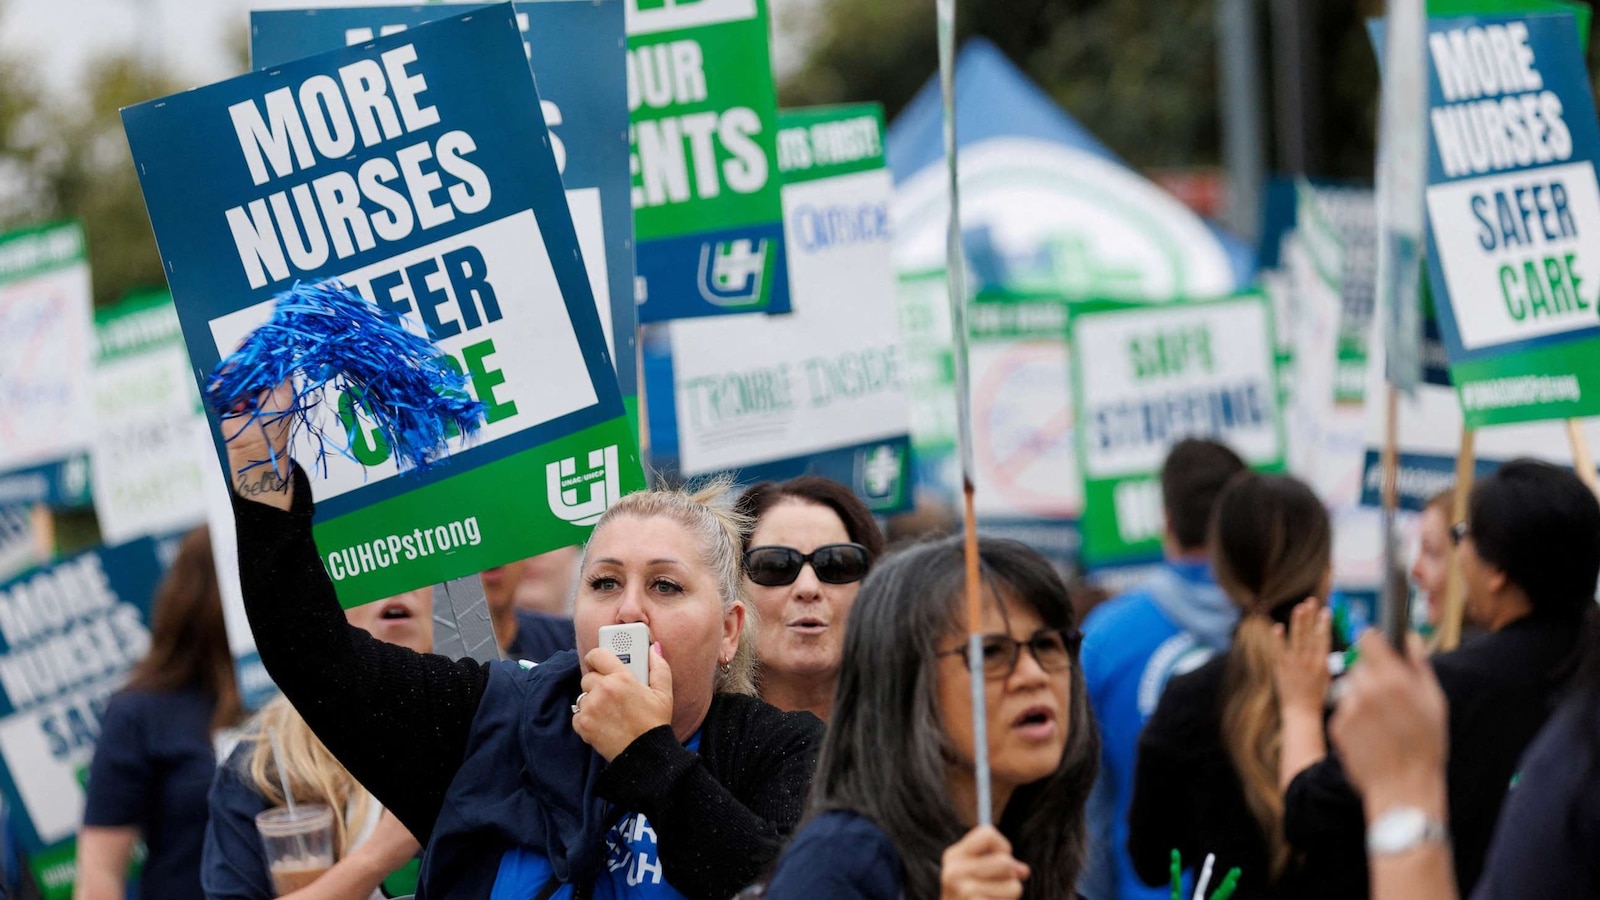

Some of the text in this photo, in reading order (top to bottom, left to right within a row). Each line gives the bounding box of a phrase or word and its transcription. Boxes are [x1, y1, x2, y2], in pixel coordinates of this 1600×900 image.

[1429, 21, 1545, 102] MORE
[228, 43, 441, 186] MORE
[1430, 90, 1573, 178] NURSES
[225, 130, 492, 290] NURSES
[1470, 183, 1578, 252] SAFER
[348, 246, 503, 344] FER
[1499, 254, 1590, 322] CARE
[320, 516, 482, 582] CUHCPstrong
